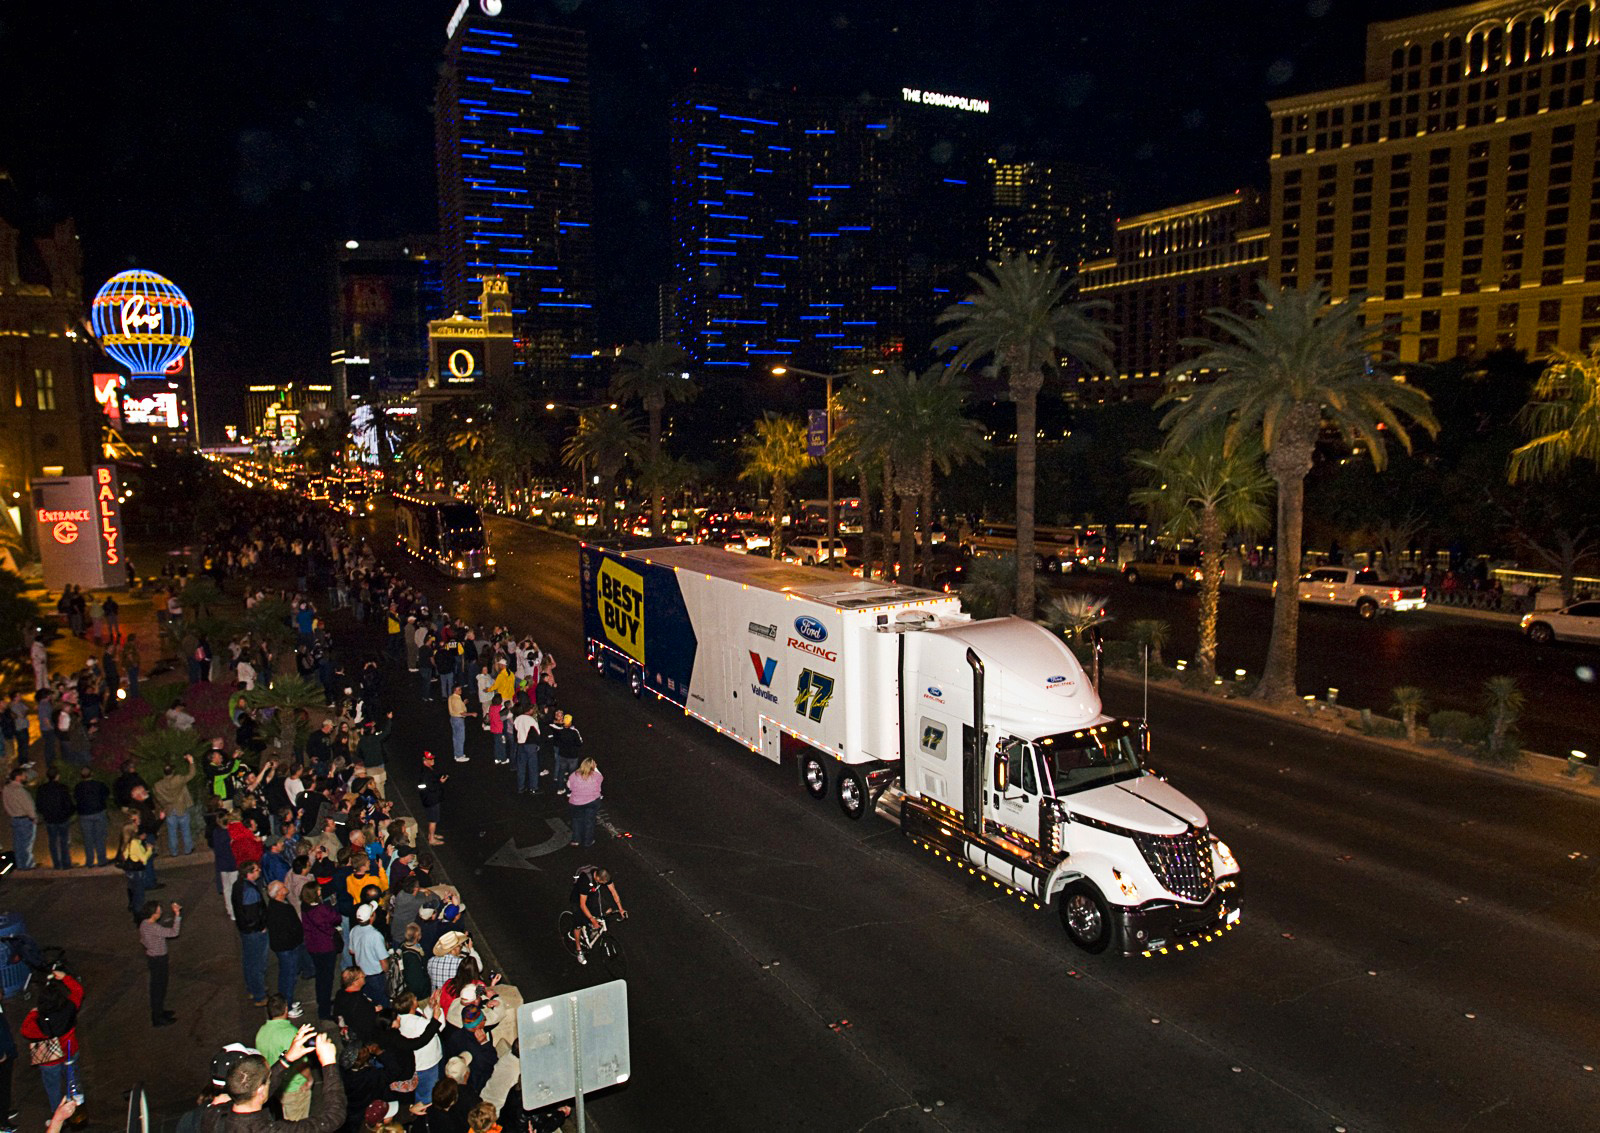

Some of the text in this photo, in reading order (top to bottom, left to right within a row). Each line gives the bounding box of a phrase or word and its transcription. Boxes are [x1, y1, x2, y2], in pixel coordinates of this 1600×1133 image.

[902, 88, 990, 114] THE COSMOPOLITAN
[601, 571, 643, 619] BEST
[604, 600, 640, 645] BUY
[800, 618, 822, 639] Ford
[786, 637, 838, 662] RACING
[751, 683, 778, 704] Valvoline
[796, 667, 835, 723] 17
